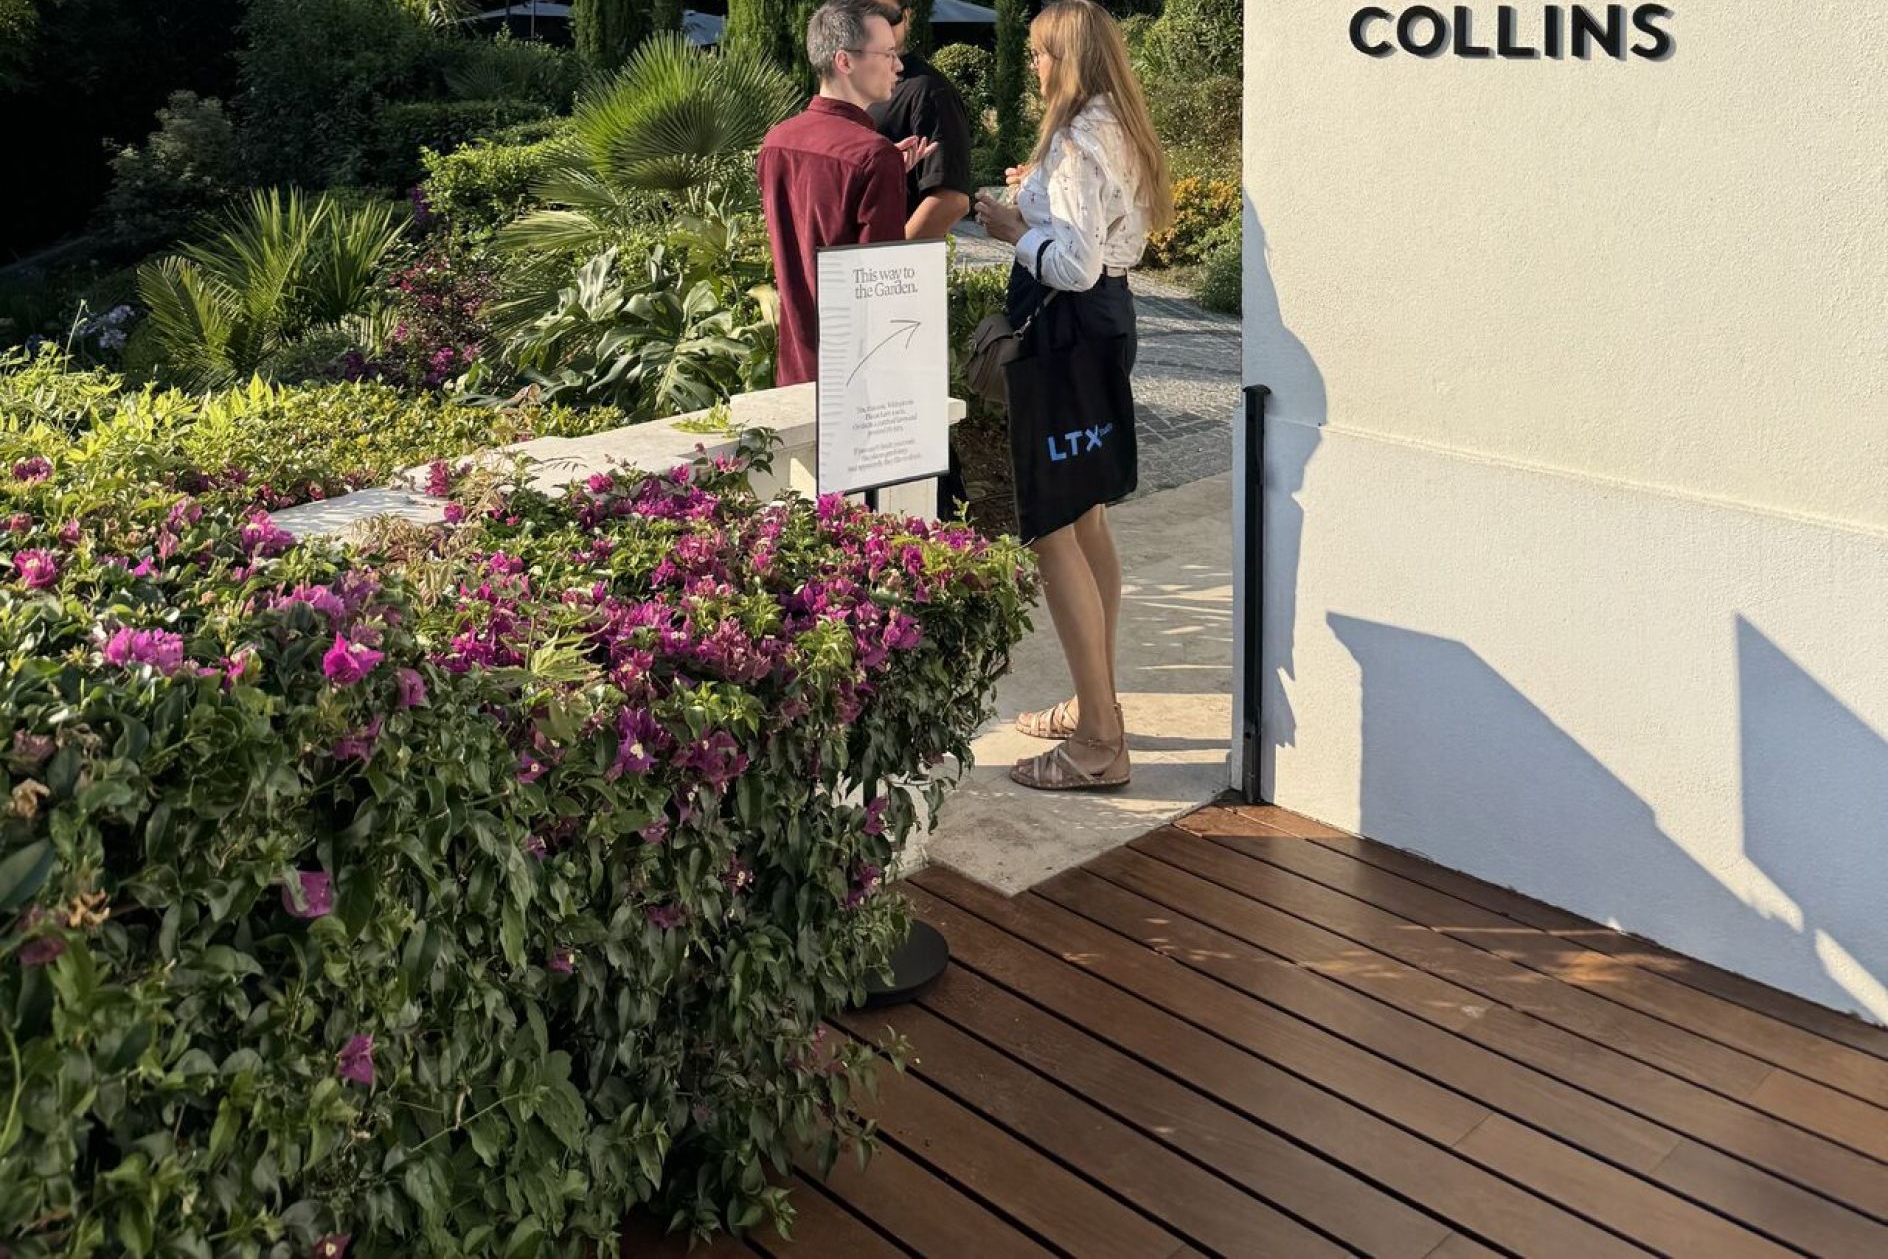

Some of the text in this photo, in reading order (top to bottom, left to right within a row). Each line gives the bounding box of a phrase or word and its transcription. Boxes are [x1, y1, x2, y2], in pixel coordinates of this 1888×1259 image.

[1349, 3, 1671, 59] COLLINS
[853, 267, 915, 284] This way to
[855, 281, 918, 299] the Garden.
[1048, 424, 1102, 461] LTX
